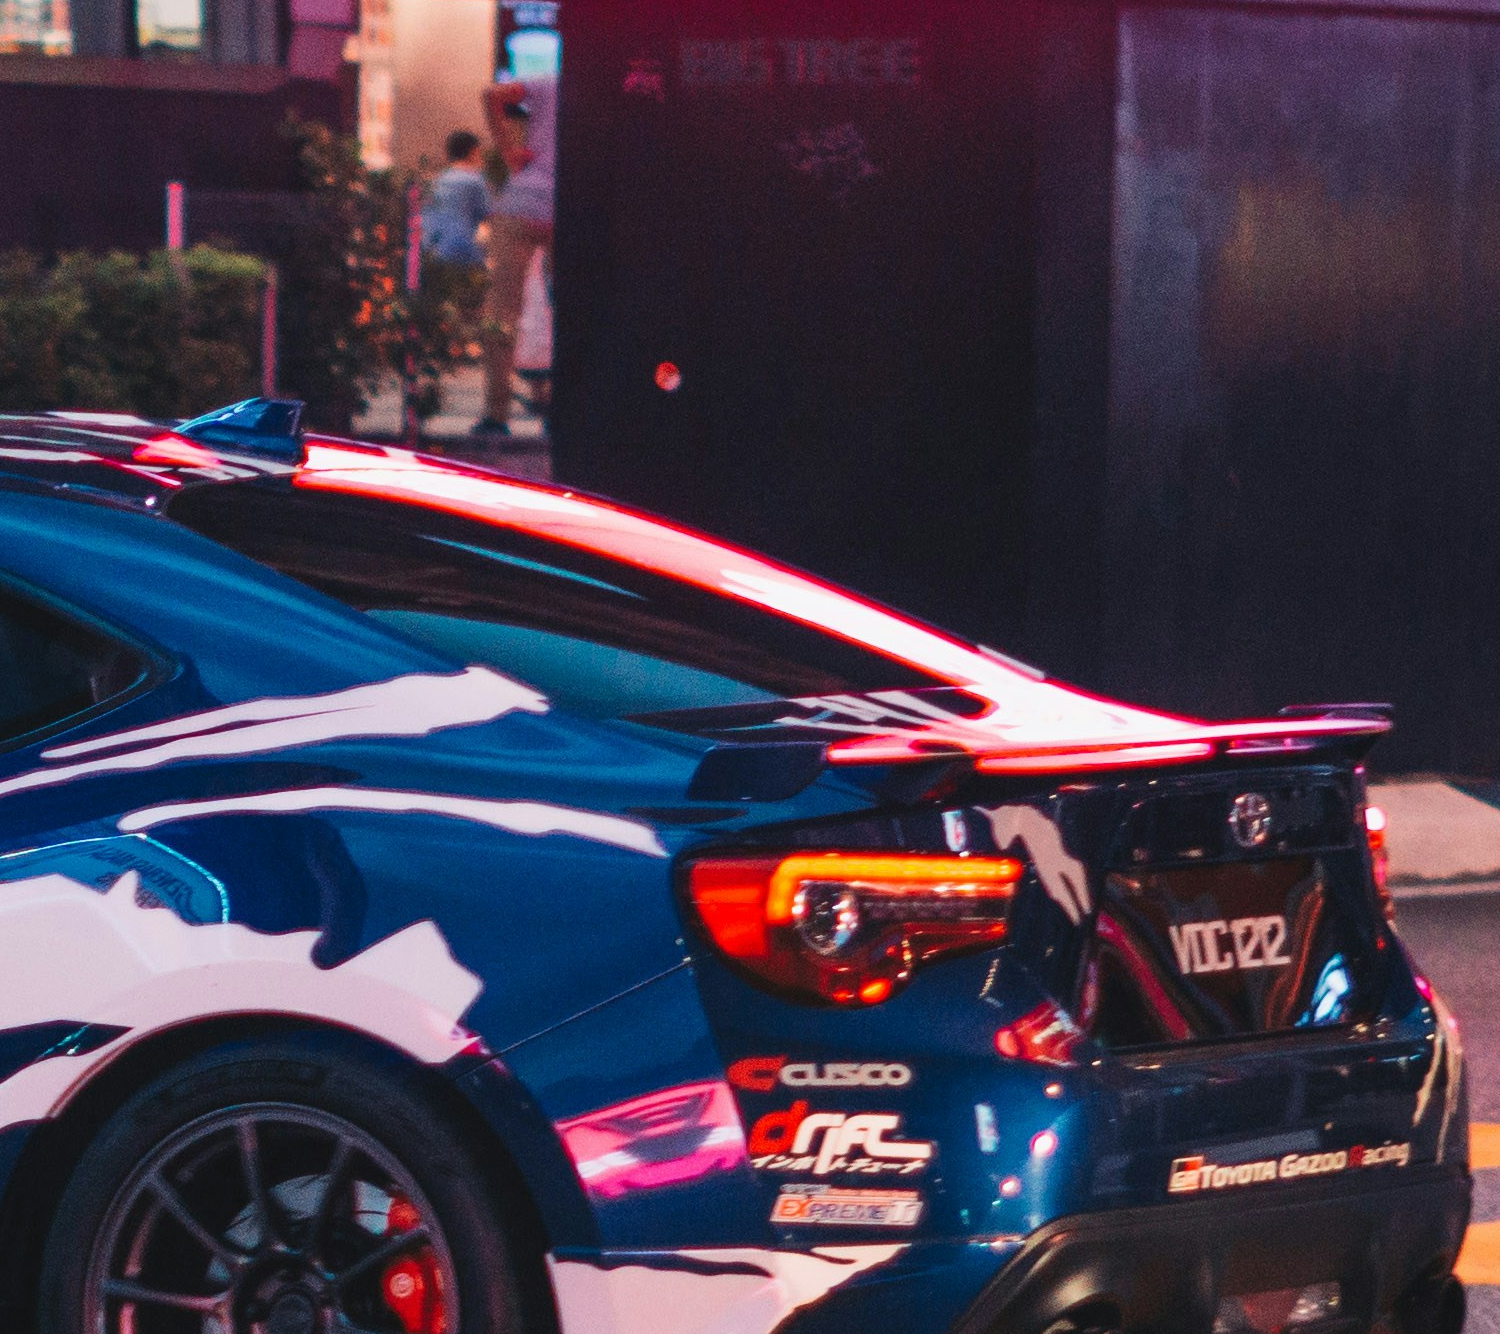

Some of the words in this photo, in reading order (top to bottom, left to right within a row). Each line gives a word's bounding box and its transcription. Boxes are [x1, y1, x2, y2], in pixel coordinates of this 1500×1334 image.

[780, 1063, 912, 1087] CUSCO
[1201, 1159, 1278, 1189] TOYOTA
[1350, 1139, 1411, 1167] Racing
